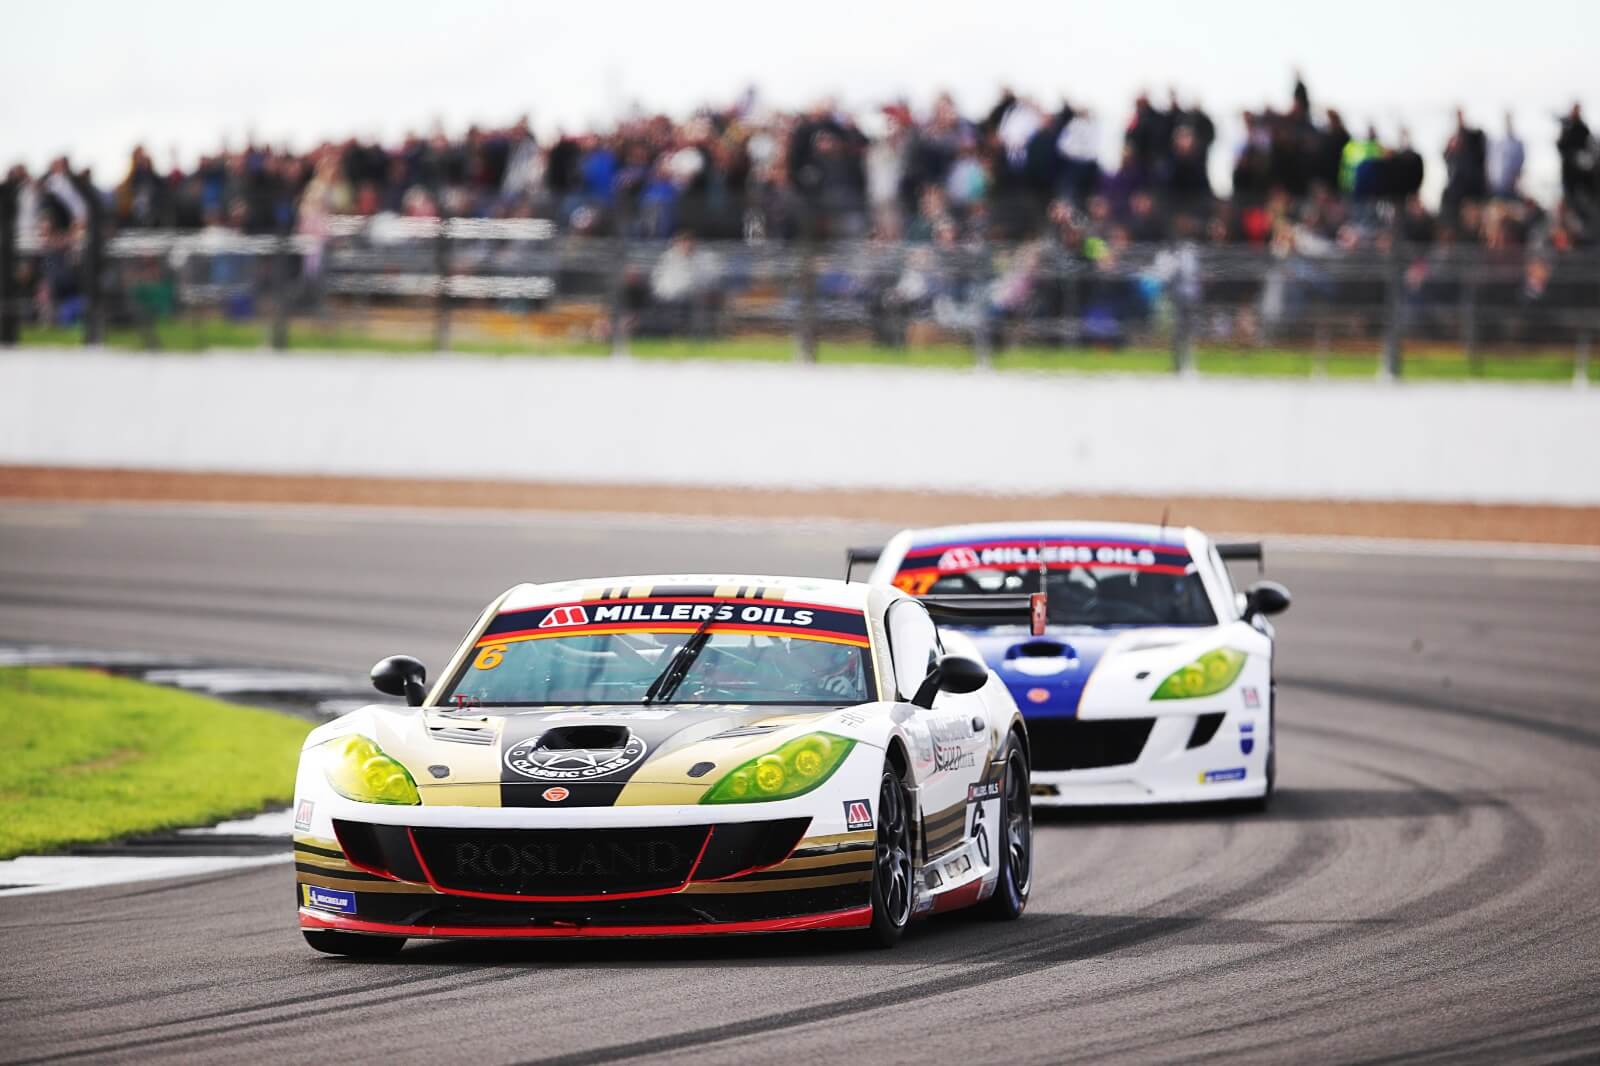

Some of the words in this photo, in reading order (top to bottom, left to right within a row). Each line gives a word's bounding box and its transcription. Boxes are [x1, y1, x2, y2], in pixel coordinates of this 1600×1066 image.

[981, 546, 1093, 566] MILLERS
[1096, 547, 1155, 566] OILS
[594, 604, 733, 622] MILLERS
[741, 606, 814, 626] OILS
[473, 644, 509, 671] 6
[512, 759, 579, 778] CLASSIC
[582, 758, 630, 776] CARS
[453, 841, 681, 876] ROSLAND
